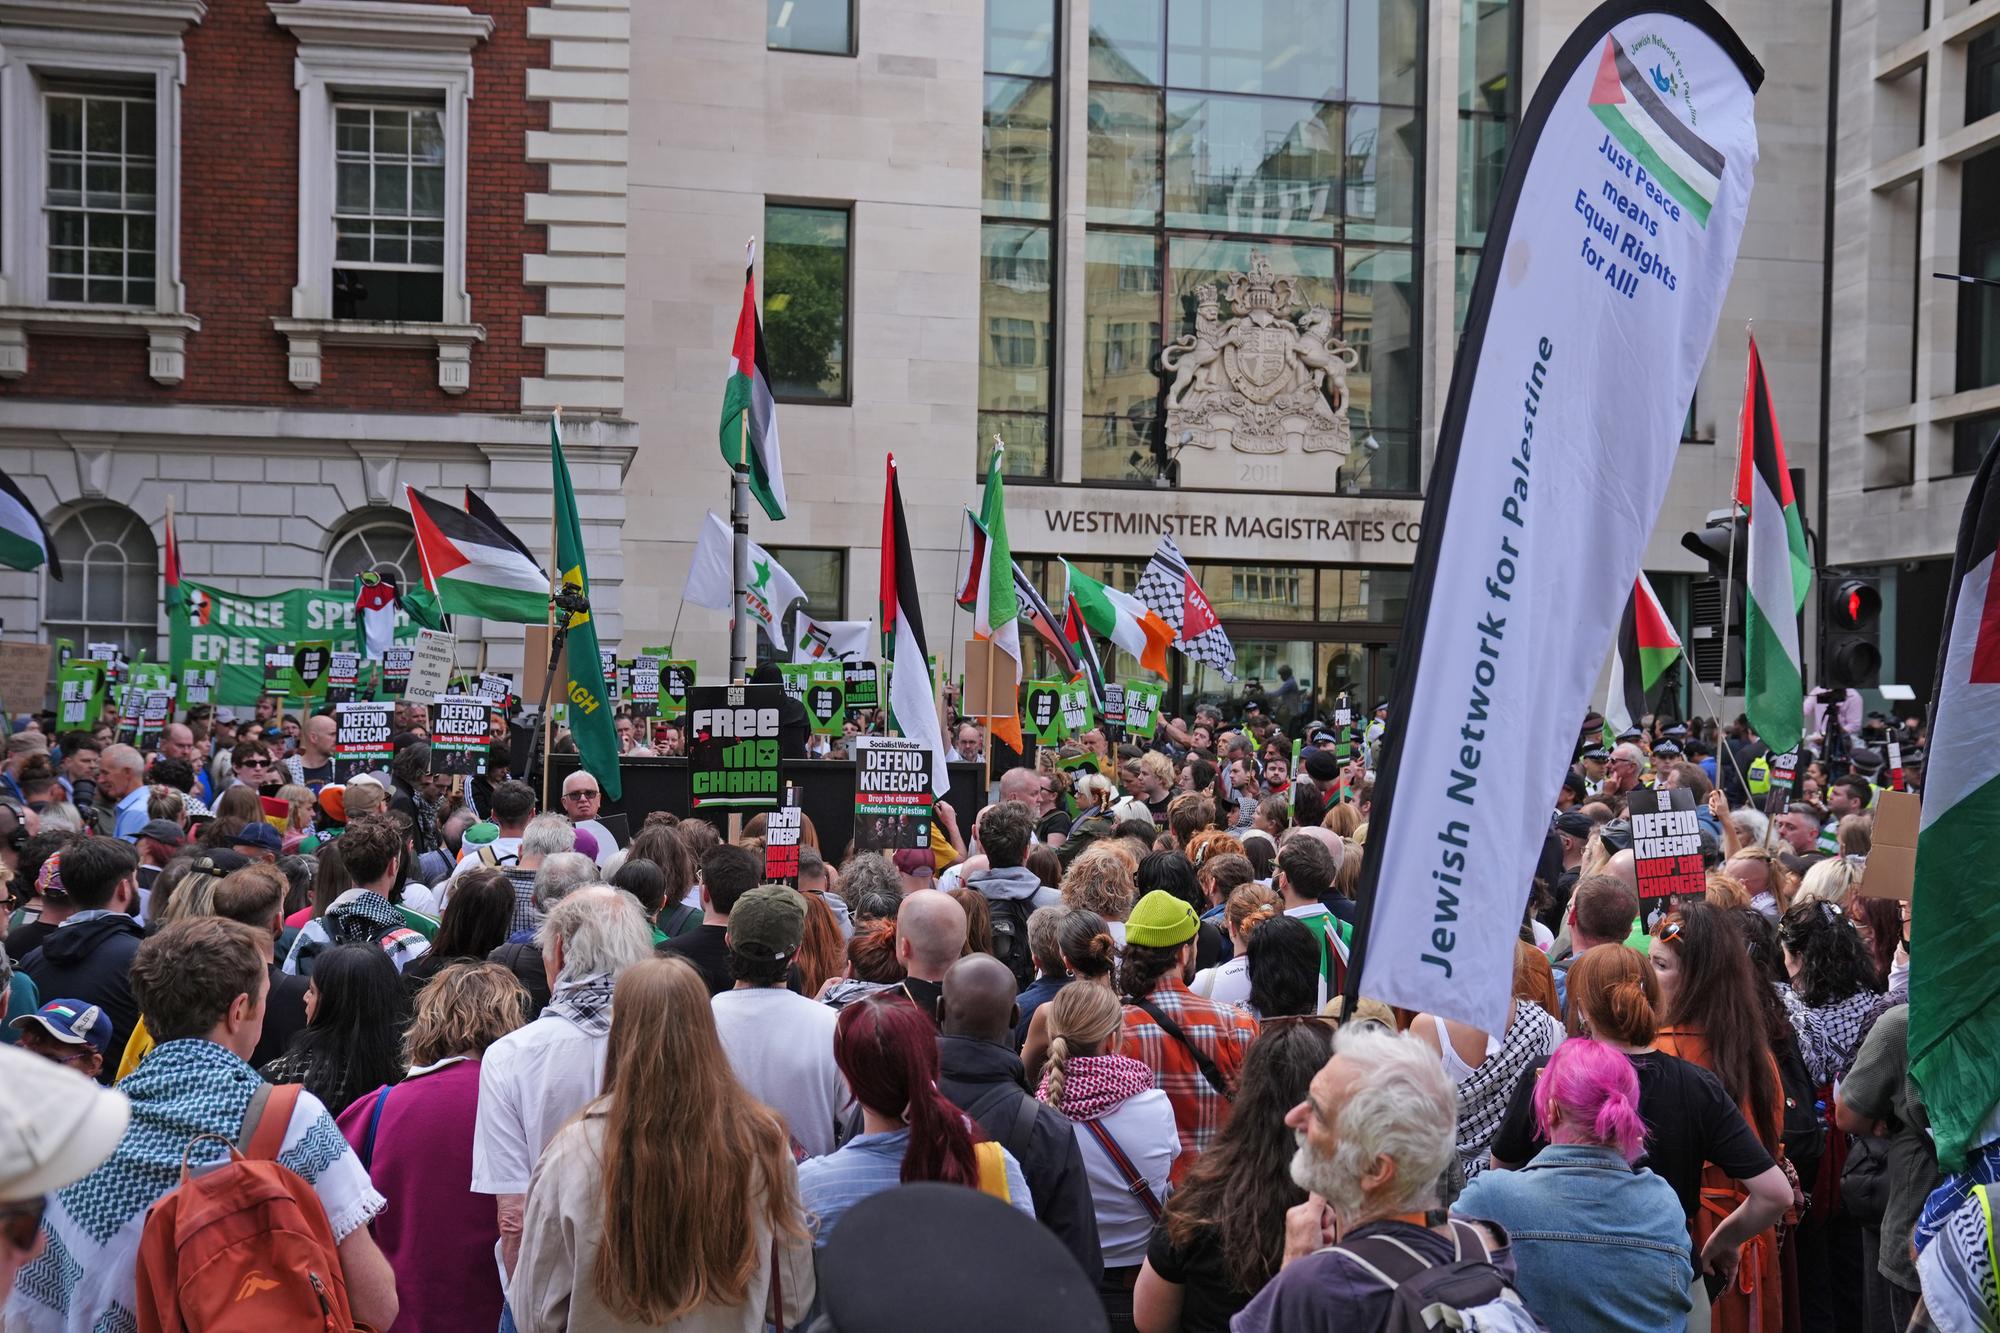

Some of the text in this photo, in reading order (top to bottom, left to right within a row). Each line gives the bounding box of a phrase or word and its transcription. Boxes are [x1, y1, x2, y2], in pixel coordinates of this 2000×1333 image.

[1631, 34, 1651, 56] Jewish
[1652, 34, 1676, 62] Network
[1598, 135, 1681, 223] Just Peace
[1602, 180, 1659, 237] means
[1574, 188, 1678, 292] Equal Rights
[1580, 237, 1640, 300] for All!
[1240, 463, 1279, 482] 2011
[1045, 510, 1217, 537] WESTMINSTER
[1225, 516, 1385, 542] MAGISTRATES
[219, 598, 285, 629] FREE
[192, 634, 261, 666] FREE
[387, 651, 412, 660] DEFEND
[418, 652, 451, 664] DESTROYED
[426, 645, 447, 654] FARMS
[1421, 336, 1553, 979] Jewish Network for Palestine
[332, 659, 356, 668] DEFEND
[420, 669, 440, 678] BOMBS
[482, 680, 505, 694] DEFEND
[635, 675, 658, 685] DEFEND
[568, 680, 600, 715] AGH
[1105, 691, 1123, 702] DEFEND
[441, 705, 485, 720] DEFEND
[1104, 702, 1125, 713] KNEECAP
[343, 713, 387, 728] DEFEND
[436, 720, 488, 735] KNEECAP
[692, 708, 780, 739] FREE
[338, 727, 391, 743] KNEECAP
[344, 744, 355, 752] Drop
[464, 744, 486, 752] Palestine
[722, 739, 779, 769] MO
[866, 751, 923, 771] DEFEND
[692, 770, 778, 794] CHARA
[860, 771, 929, 792] KNEECAP
[868, 795, 883, 804] Drop
[895, 796, 919, 804] charges
[861, 805, 926, 815] Freedom for Palestine
[1632, 810, 1700, 839] DEFEND
[1634, 834, 1702, 860] KNEECAP
[1636, 854, 1704, 878] DROP THE
[1638, 873, 1706, 898] CHARGES
